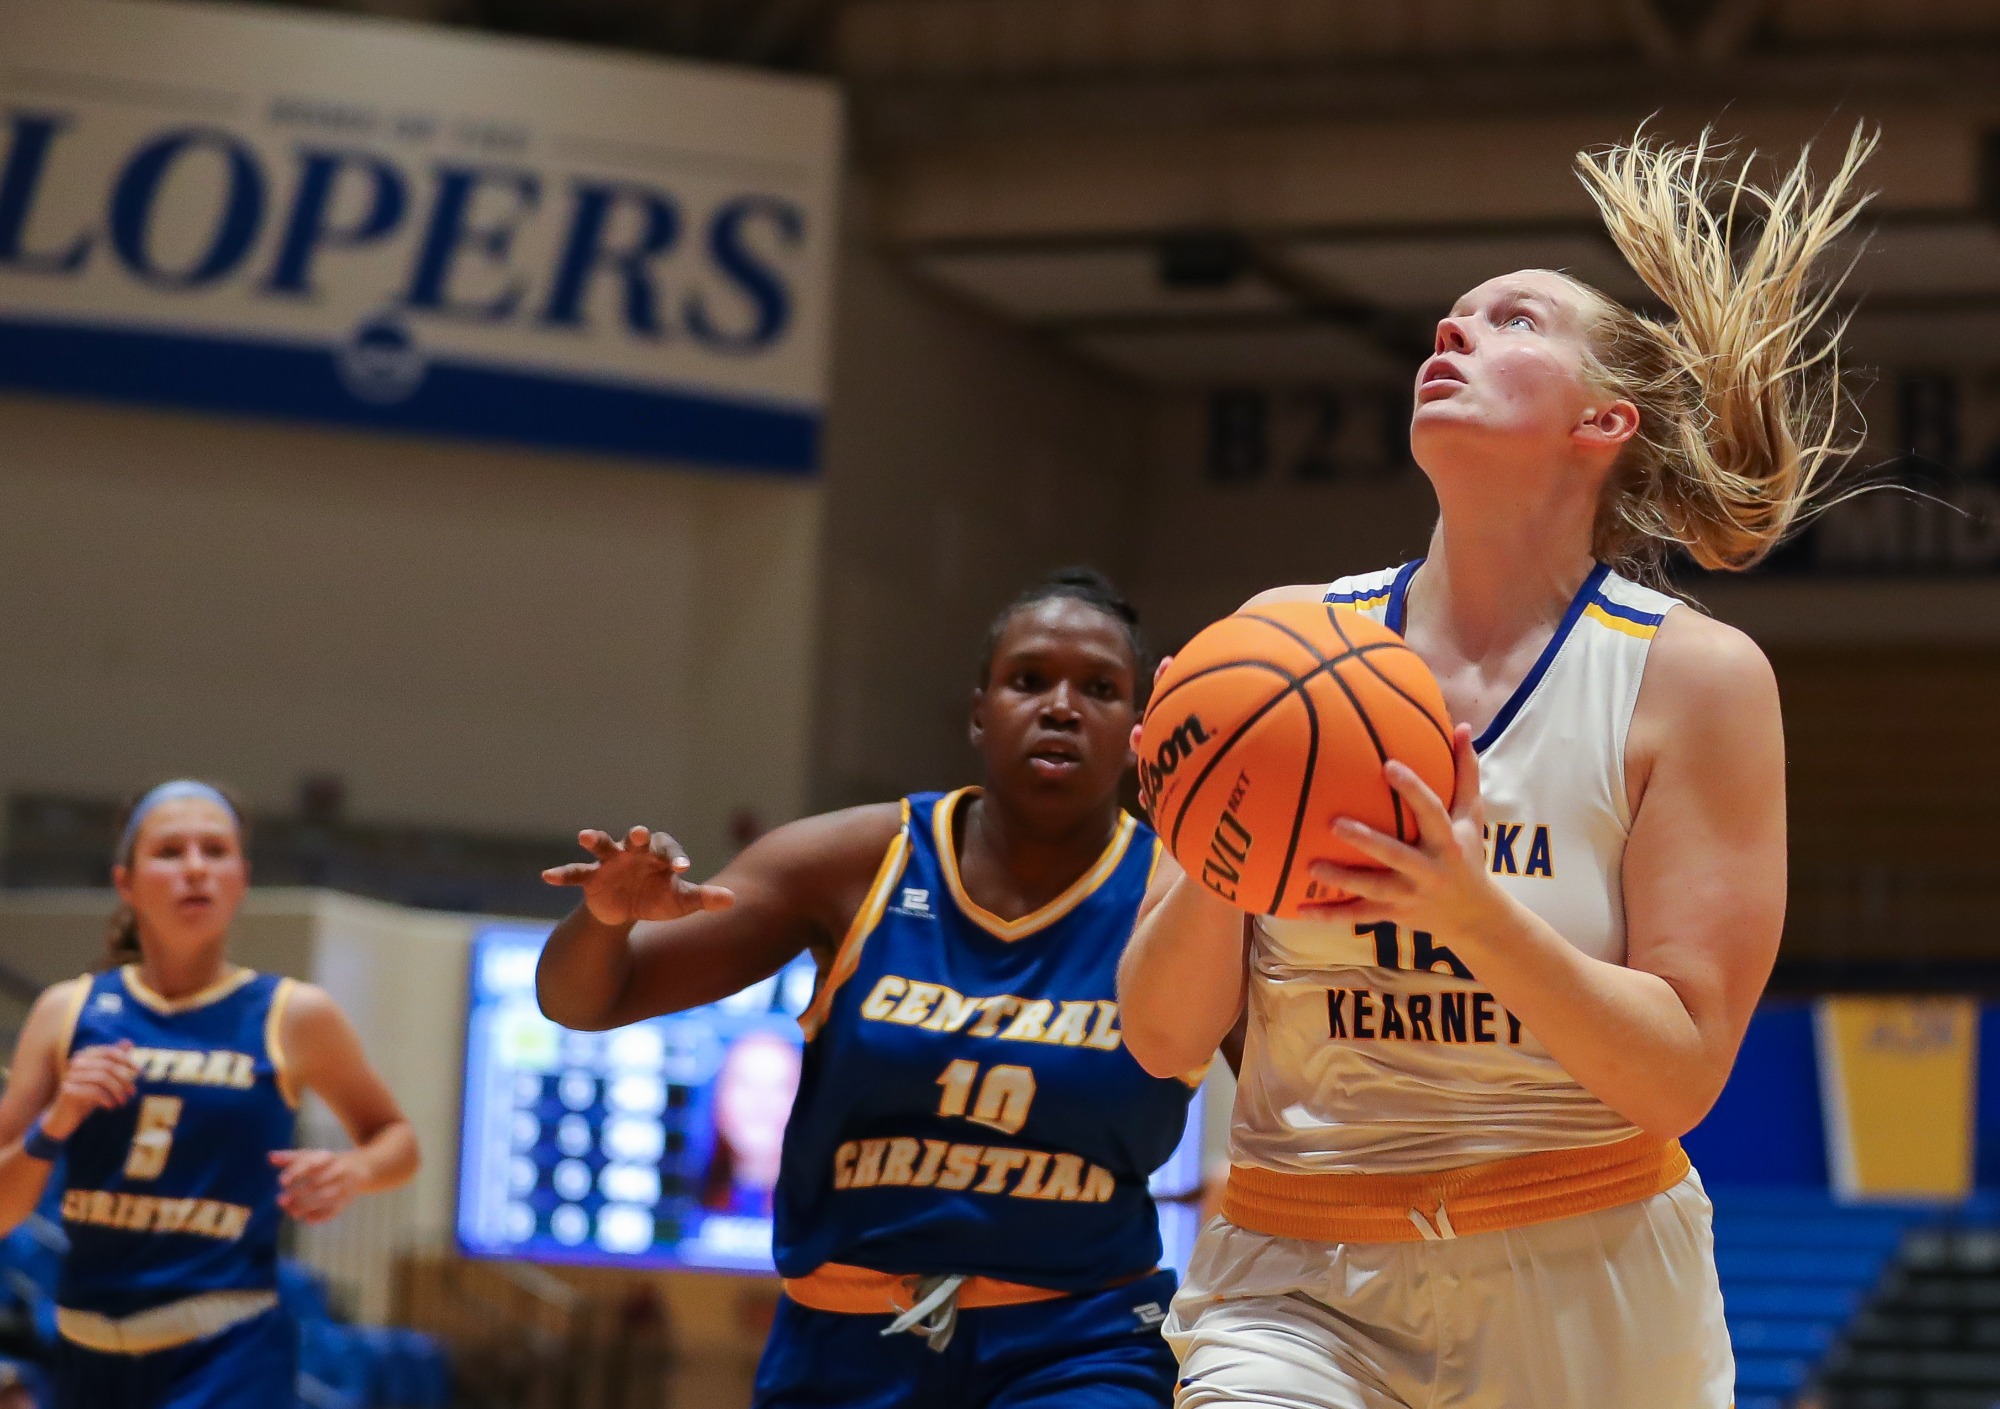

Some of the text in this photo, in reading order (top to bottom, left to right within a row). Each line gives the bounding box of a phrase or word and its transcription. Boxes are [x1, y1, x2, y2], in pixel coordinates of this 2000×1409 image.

[0, 106, 808, 357] LOPERS
[1138, 713, 1211, 835] lson
[1201, 810, 1254, 904] EVO
[860, 974, 1123, 1051] CENTRAL
[935, 1058, 1037, 1136] 10
[834, 1137, 1117, 1203] CHRISTIAN
